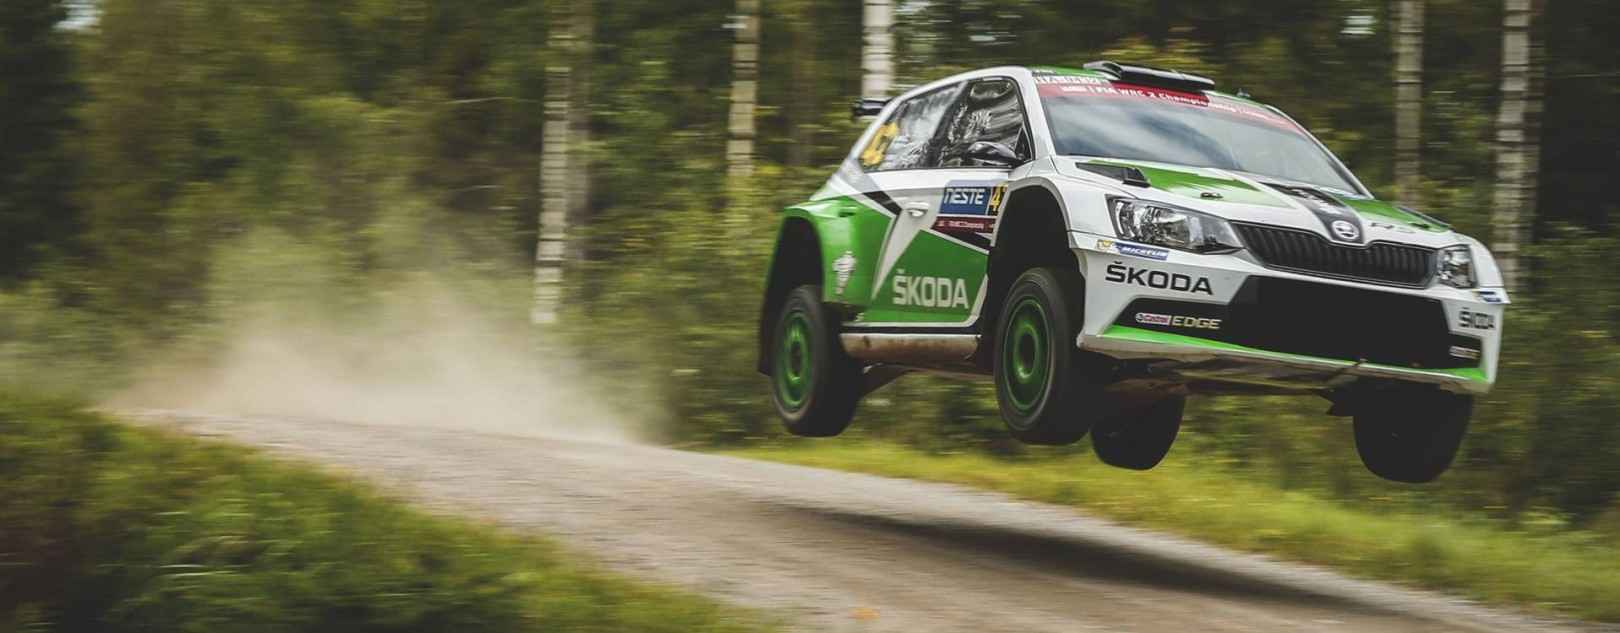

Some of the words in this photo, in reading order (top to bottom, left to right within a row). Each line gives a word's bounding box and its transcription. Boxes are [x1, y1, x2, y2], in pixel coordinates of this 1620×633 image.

[943, 188, 986, 205] NESTE
[892, 269, 968, 309] ŠKODA
[1105, 261, 1213, 295] ŠKODA
[1172, 316, 1222, 330] EDGE
